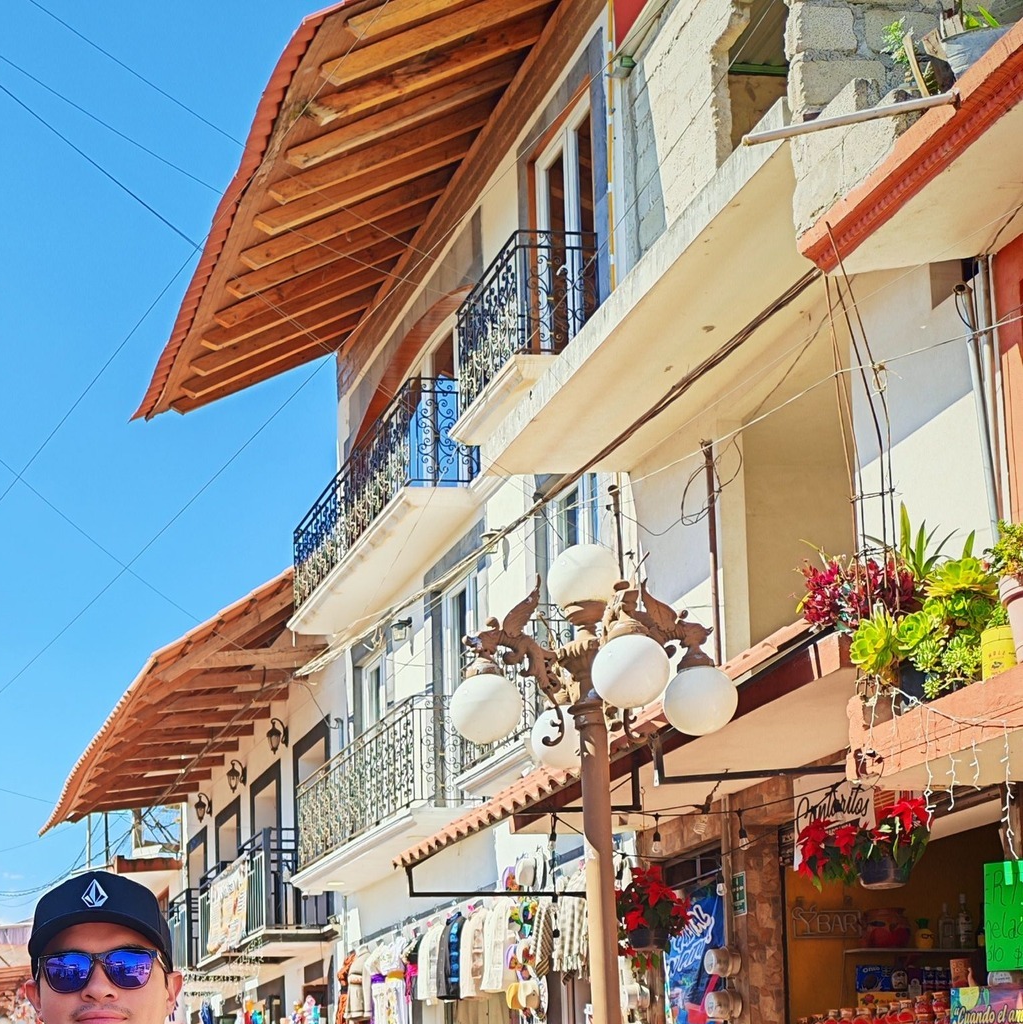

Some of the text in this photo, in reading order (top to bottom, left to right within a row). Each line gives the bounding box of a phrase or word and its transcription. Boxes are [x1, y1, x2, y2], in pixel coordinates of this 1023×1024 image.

[796, 784, 870, 834] Cntaritos
[817, 913, 858, 933] BAR
[997, 1004, 1008, 1024] el
